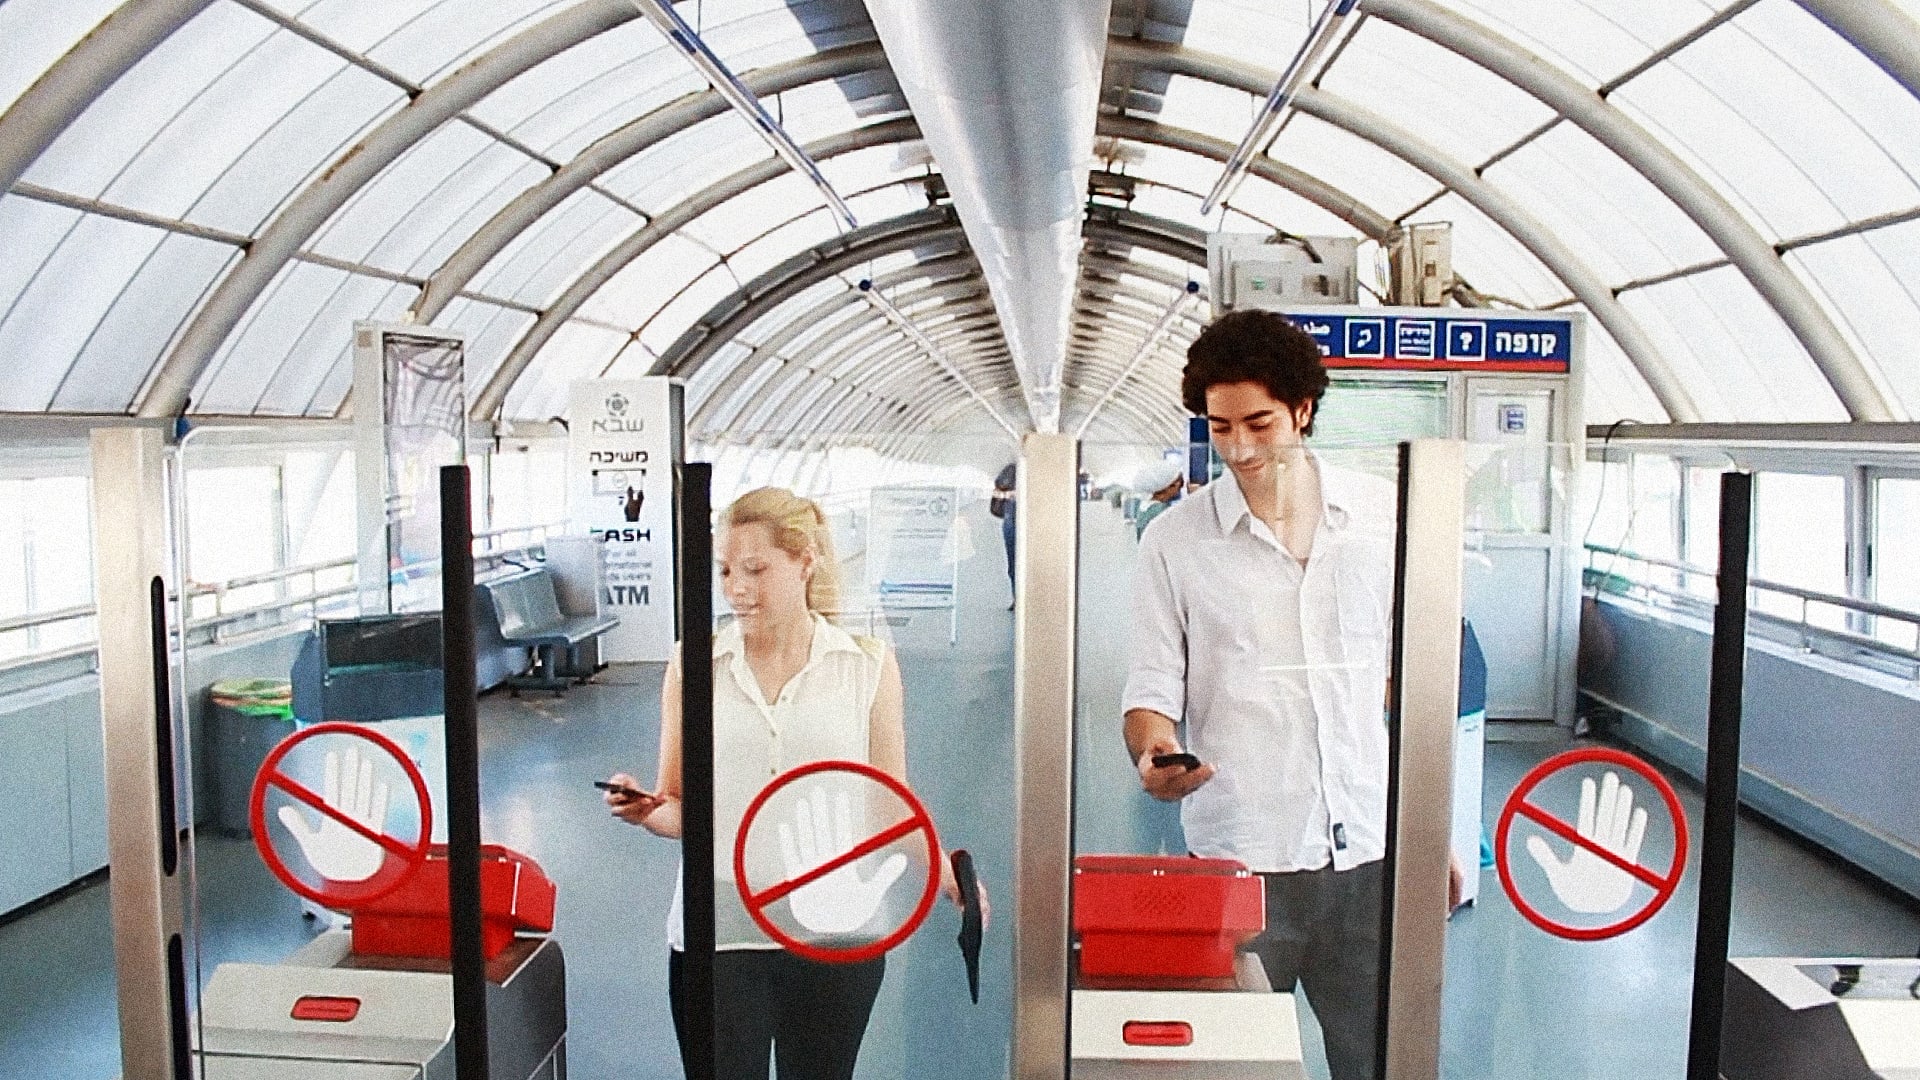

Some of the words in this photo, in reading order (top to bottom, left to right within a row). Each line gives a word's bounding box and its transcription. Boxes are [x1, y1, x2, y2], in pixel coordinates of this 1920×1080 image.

[1496, 331, 1557, 357] קופה
[592, 418, 644, 432] שבא
[590, 451, 649, 463] משיכה
